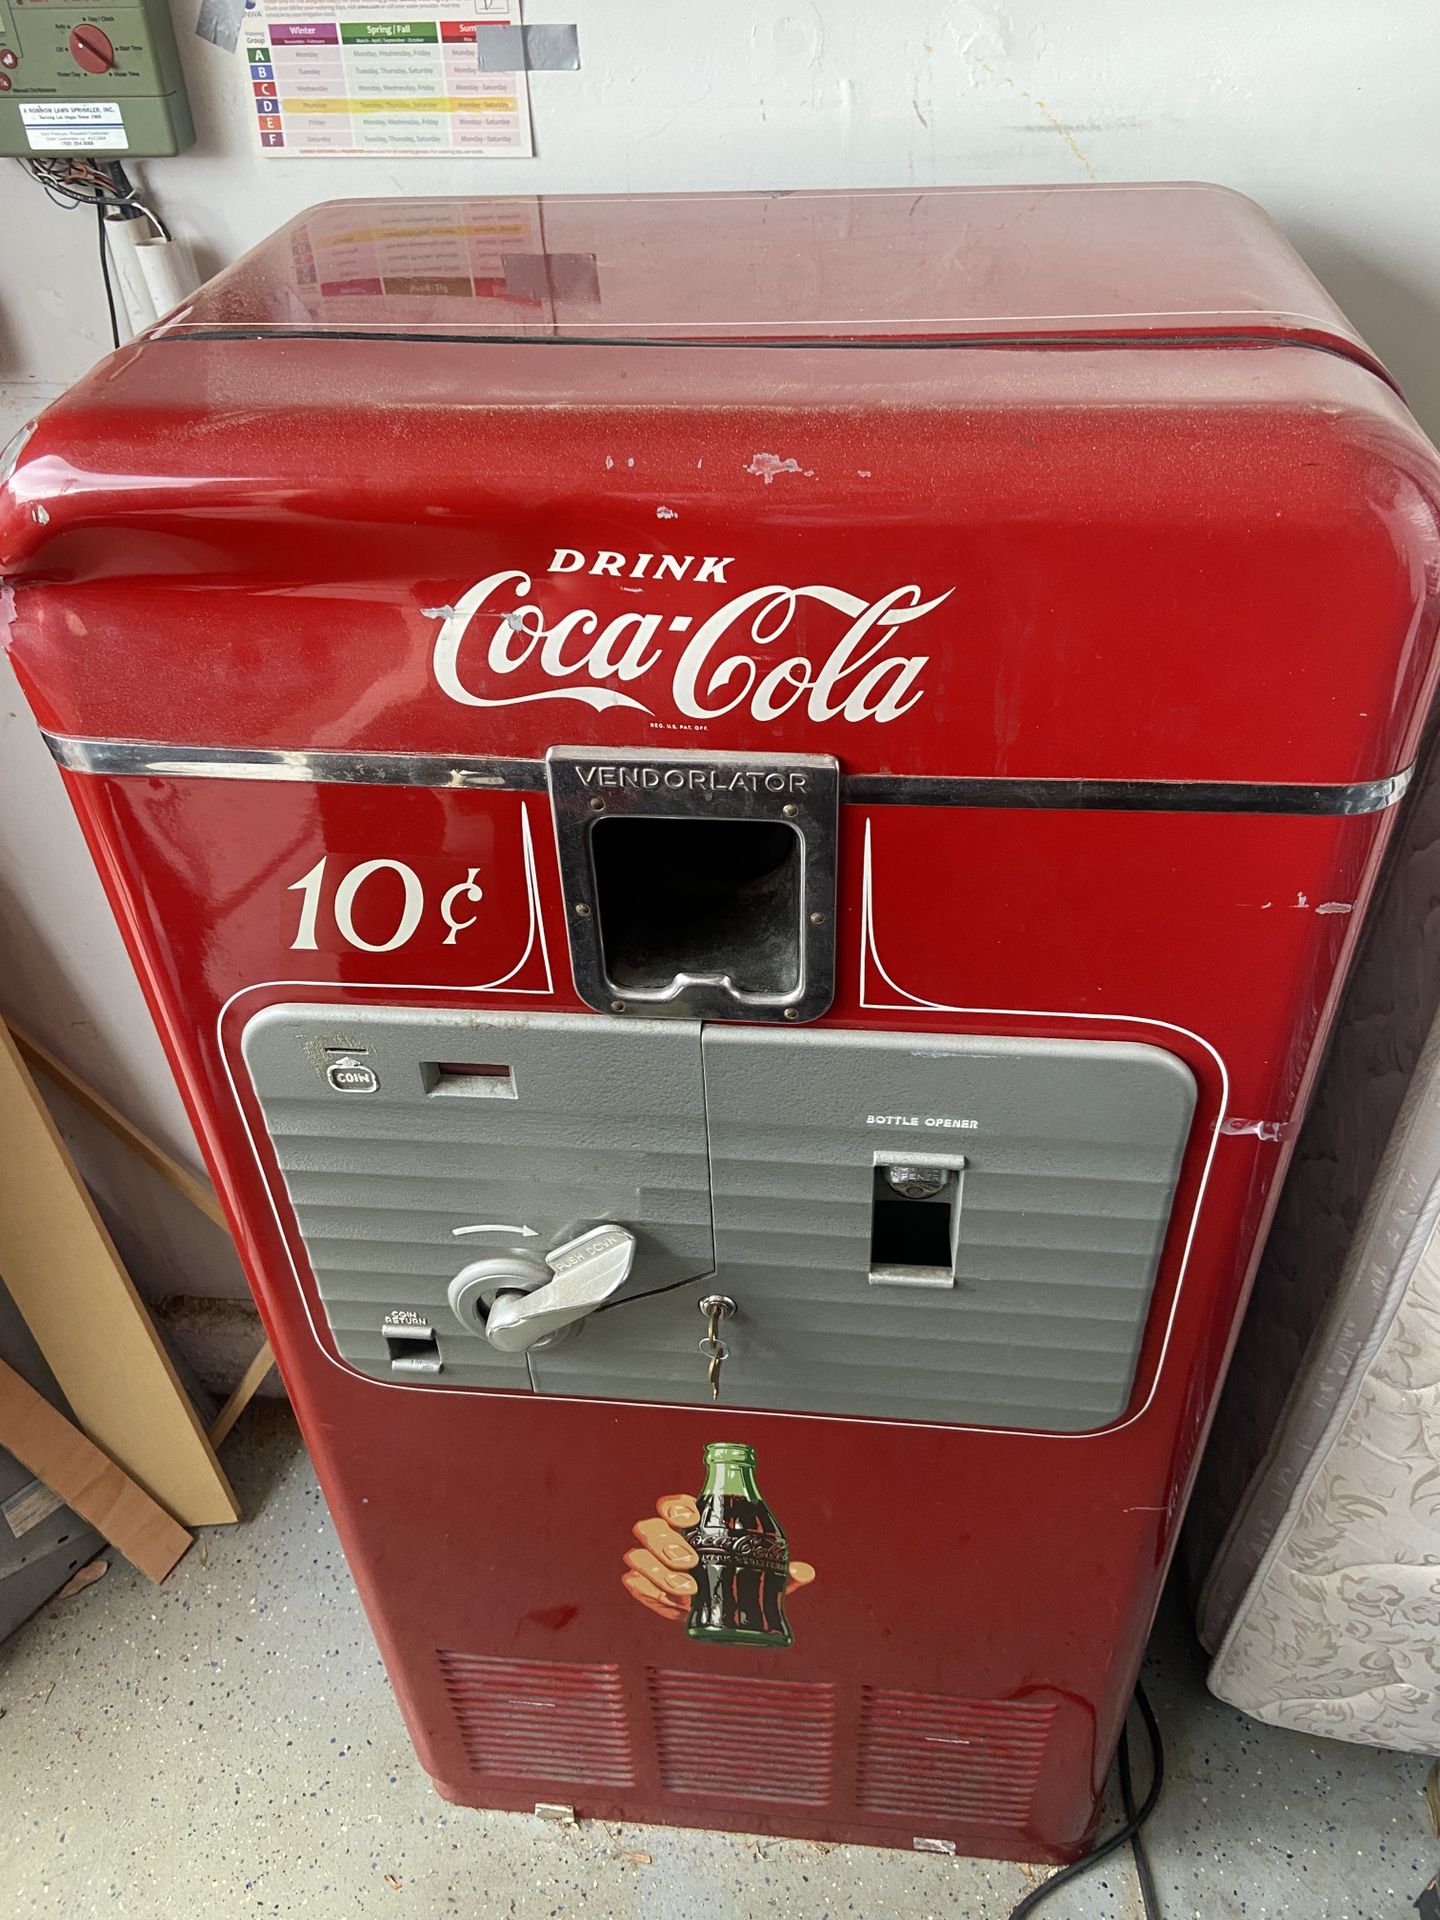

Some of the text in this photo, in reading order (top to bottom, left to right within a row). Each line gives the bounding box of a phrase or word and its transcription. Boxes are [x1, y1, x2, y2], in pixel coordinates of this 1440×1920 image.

[289, 26, 316, 35] Winter
[366, 25, 392, 36] Spring
[396, 25, 411, 33] Fall
[459, 24, 477, 33] Sum
[255, 50, 264, 61] A
[258, 67, 267, 78] B
[261, 83, 270, 95] C
[263, 101, 273, 112] D
[266, 117, 274, 128] E
[269, 133, 277, 145] F
[547, 548, 736, 584] DRINK
[433, 569, 957, 723] Coca-Cola
[575, 765, 808, 794] VENDORLATOR
[336, 1072, 371, 1083] COIN
[866, 1115, 979, 1129] BOTTLE OPENER
[556, 1252, 585, 1272] PUSH
[391, 1310, 417, 1318] COIN
[384, 1316, 427, 1325] RETURN
